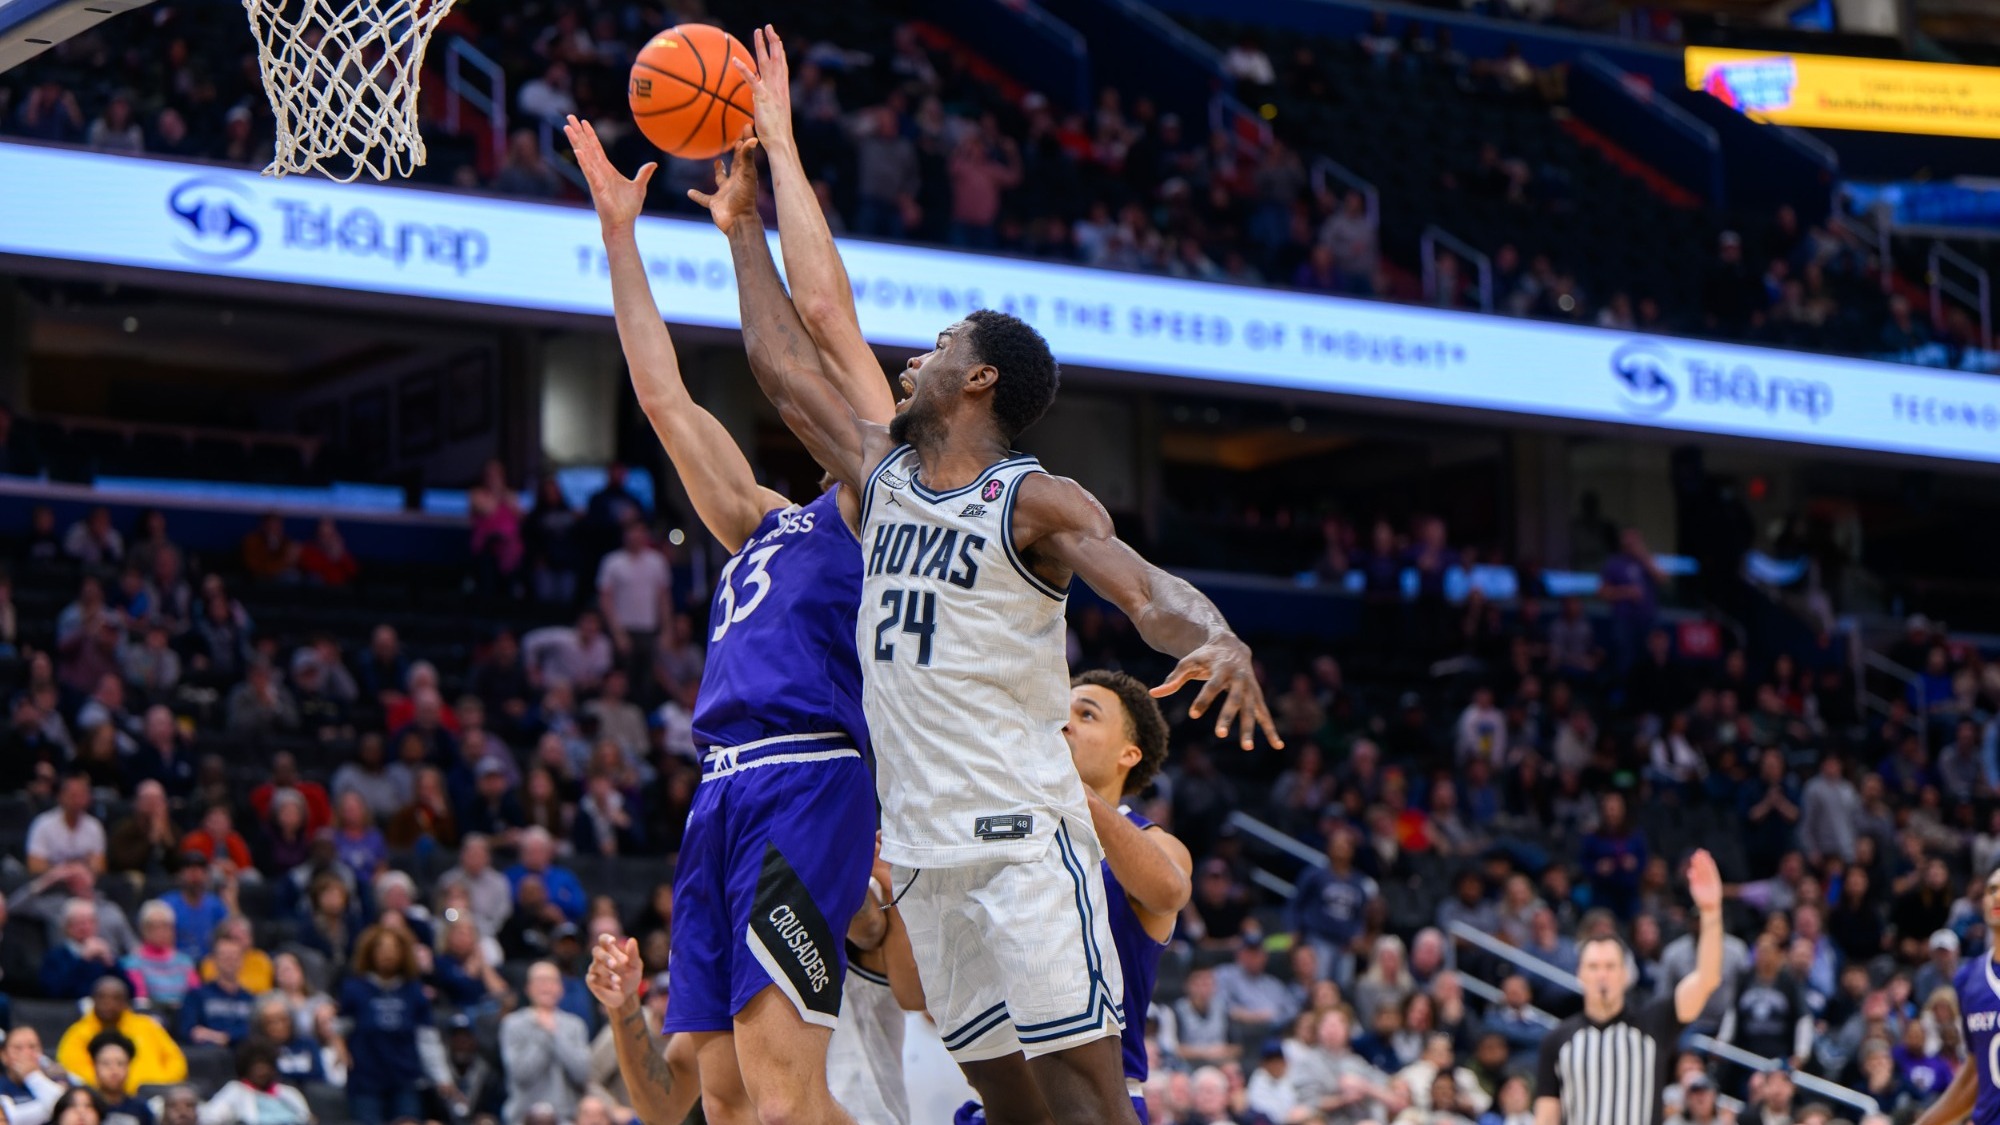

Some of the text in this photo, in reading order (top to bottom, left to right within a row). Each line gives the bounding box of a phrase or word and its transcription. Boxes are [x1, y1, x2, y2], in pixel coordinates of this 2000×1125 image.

[1053, 298, 1115, 334] THE
[1128, 306, 1232, 345] SPEED
[1243, 319, 1286, 351] OF
[867, 524, 986, 589] HOYAS
[711, 544, 783, 642] 33
[874, 589, 937, 667] 24
[1016, 820, 1028, 829] 48
[768, 904, 830, 993] CRUSADERS
